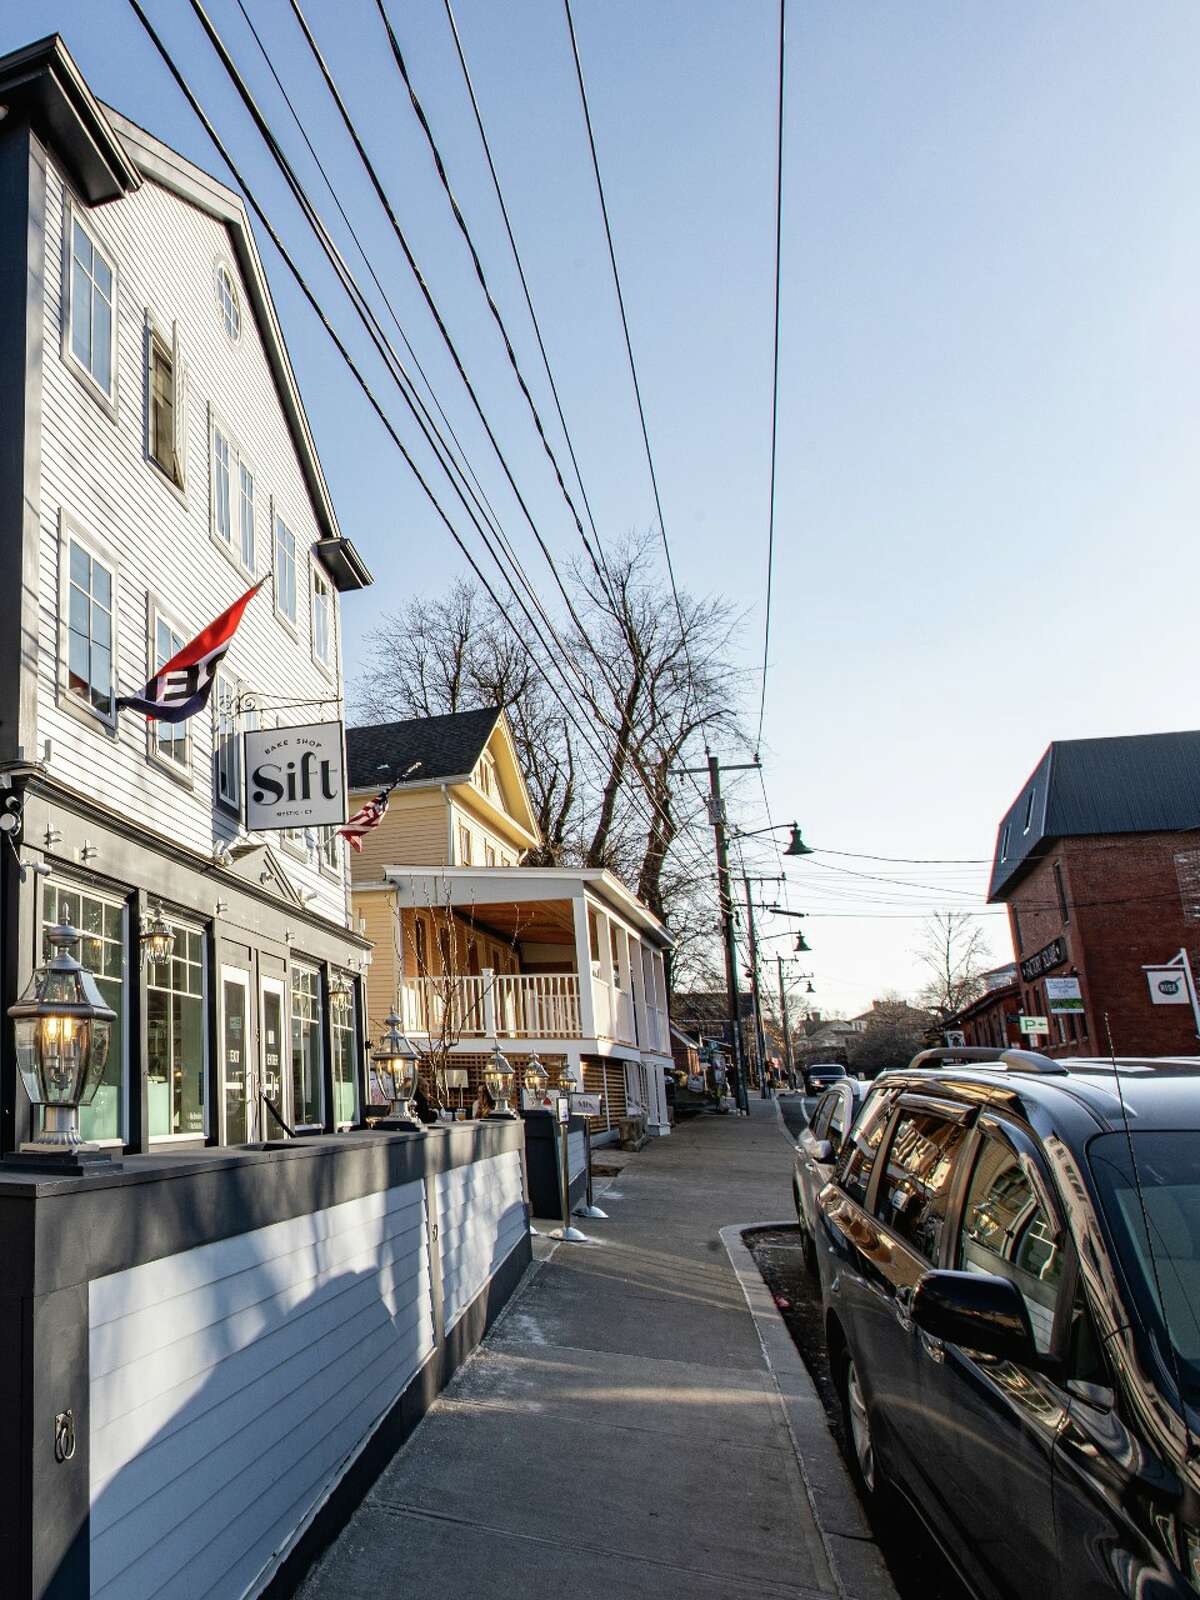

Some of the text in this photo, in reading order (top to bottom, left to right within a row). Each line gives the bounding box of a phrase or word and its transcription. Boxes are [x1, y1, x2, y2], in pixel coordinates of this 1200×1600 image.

[264, 738, 323, 755] BAKE SHOP
[251, 751, 338, 806] Sift
[1024, 1019, 1037, 1031] P
